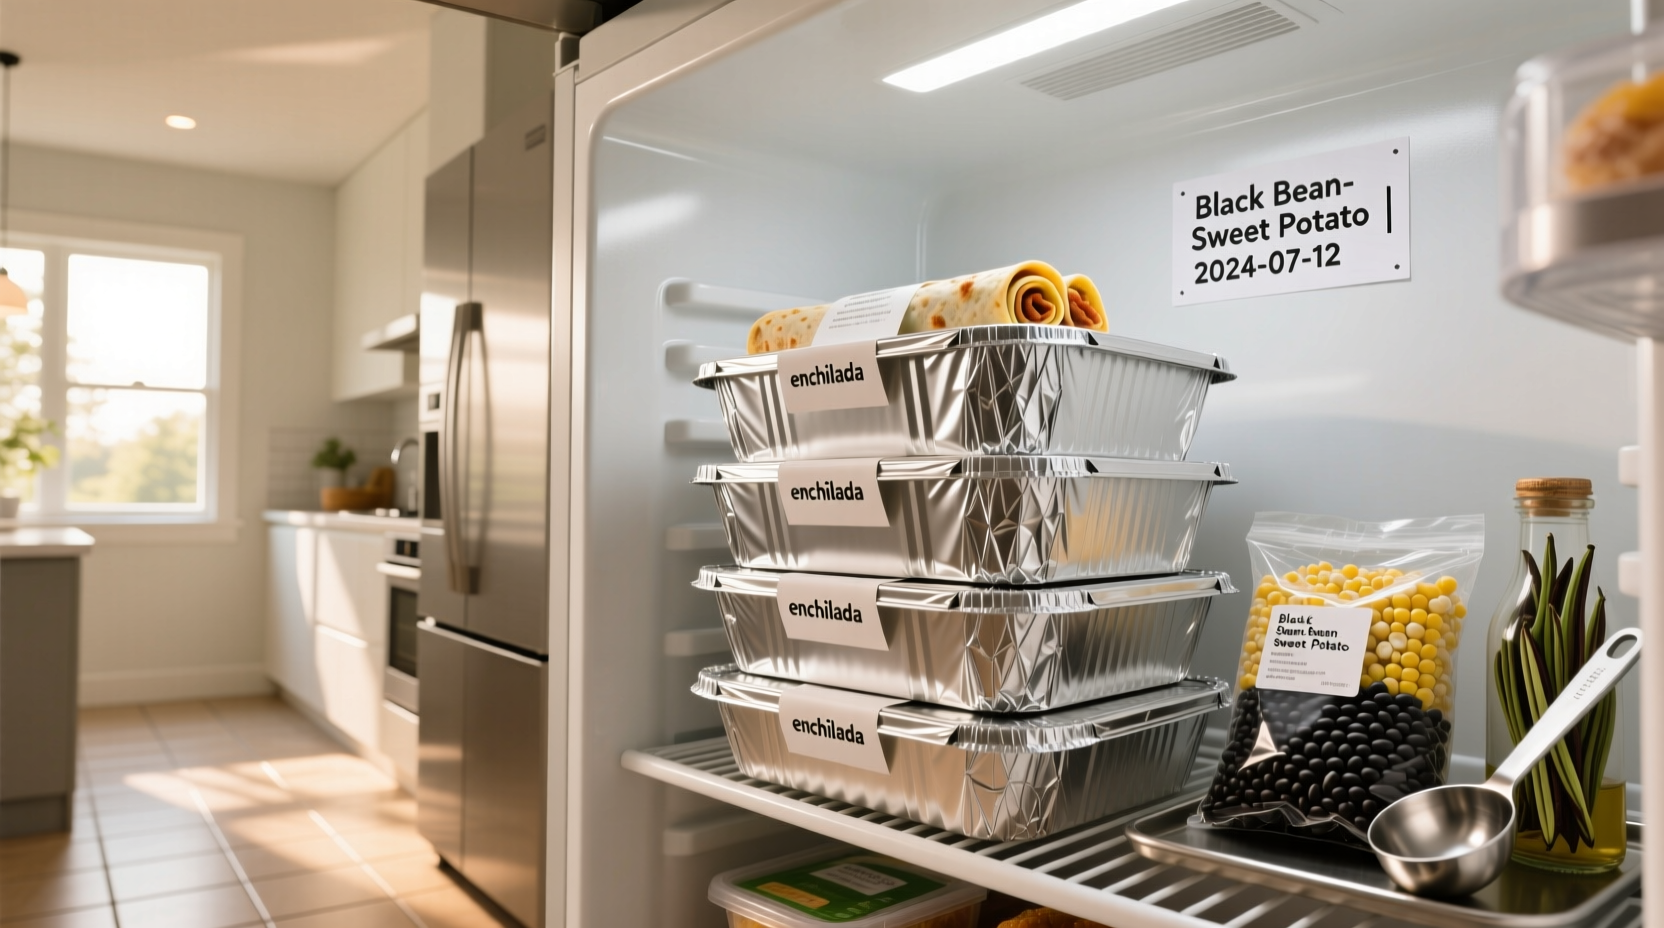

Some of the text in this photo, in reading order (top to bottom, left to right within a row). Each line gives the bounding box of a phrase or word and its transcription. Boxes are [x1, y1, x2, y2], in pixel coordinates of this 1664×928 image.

[1195, 177, 1354, 220] Black Bean-
[1191, 205, 1370, 251] Sweet Potato
[1194, 242, 1341, 285] 2024-07-12
[790, 361, 865, 388] enchilada
[790, 480, 865, 501] enchilada
[788, 598, 864, 624] enchilada
[792, 717, 865, 746] enchilada
